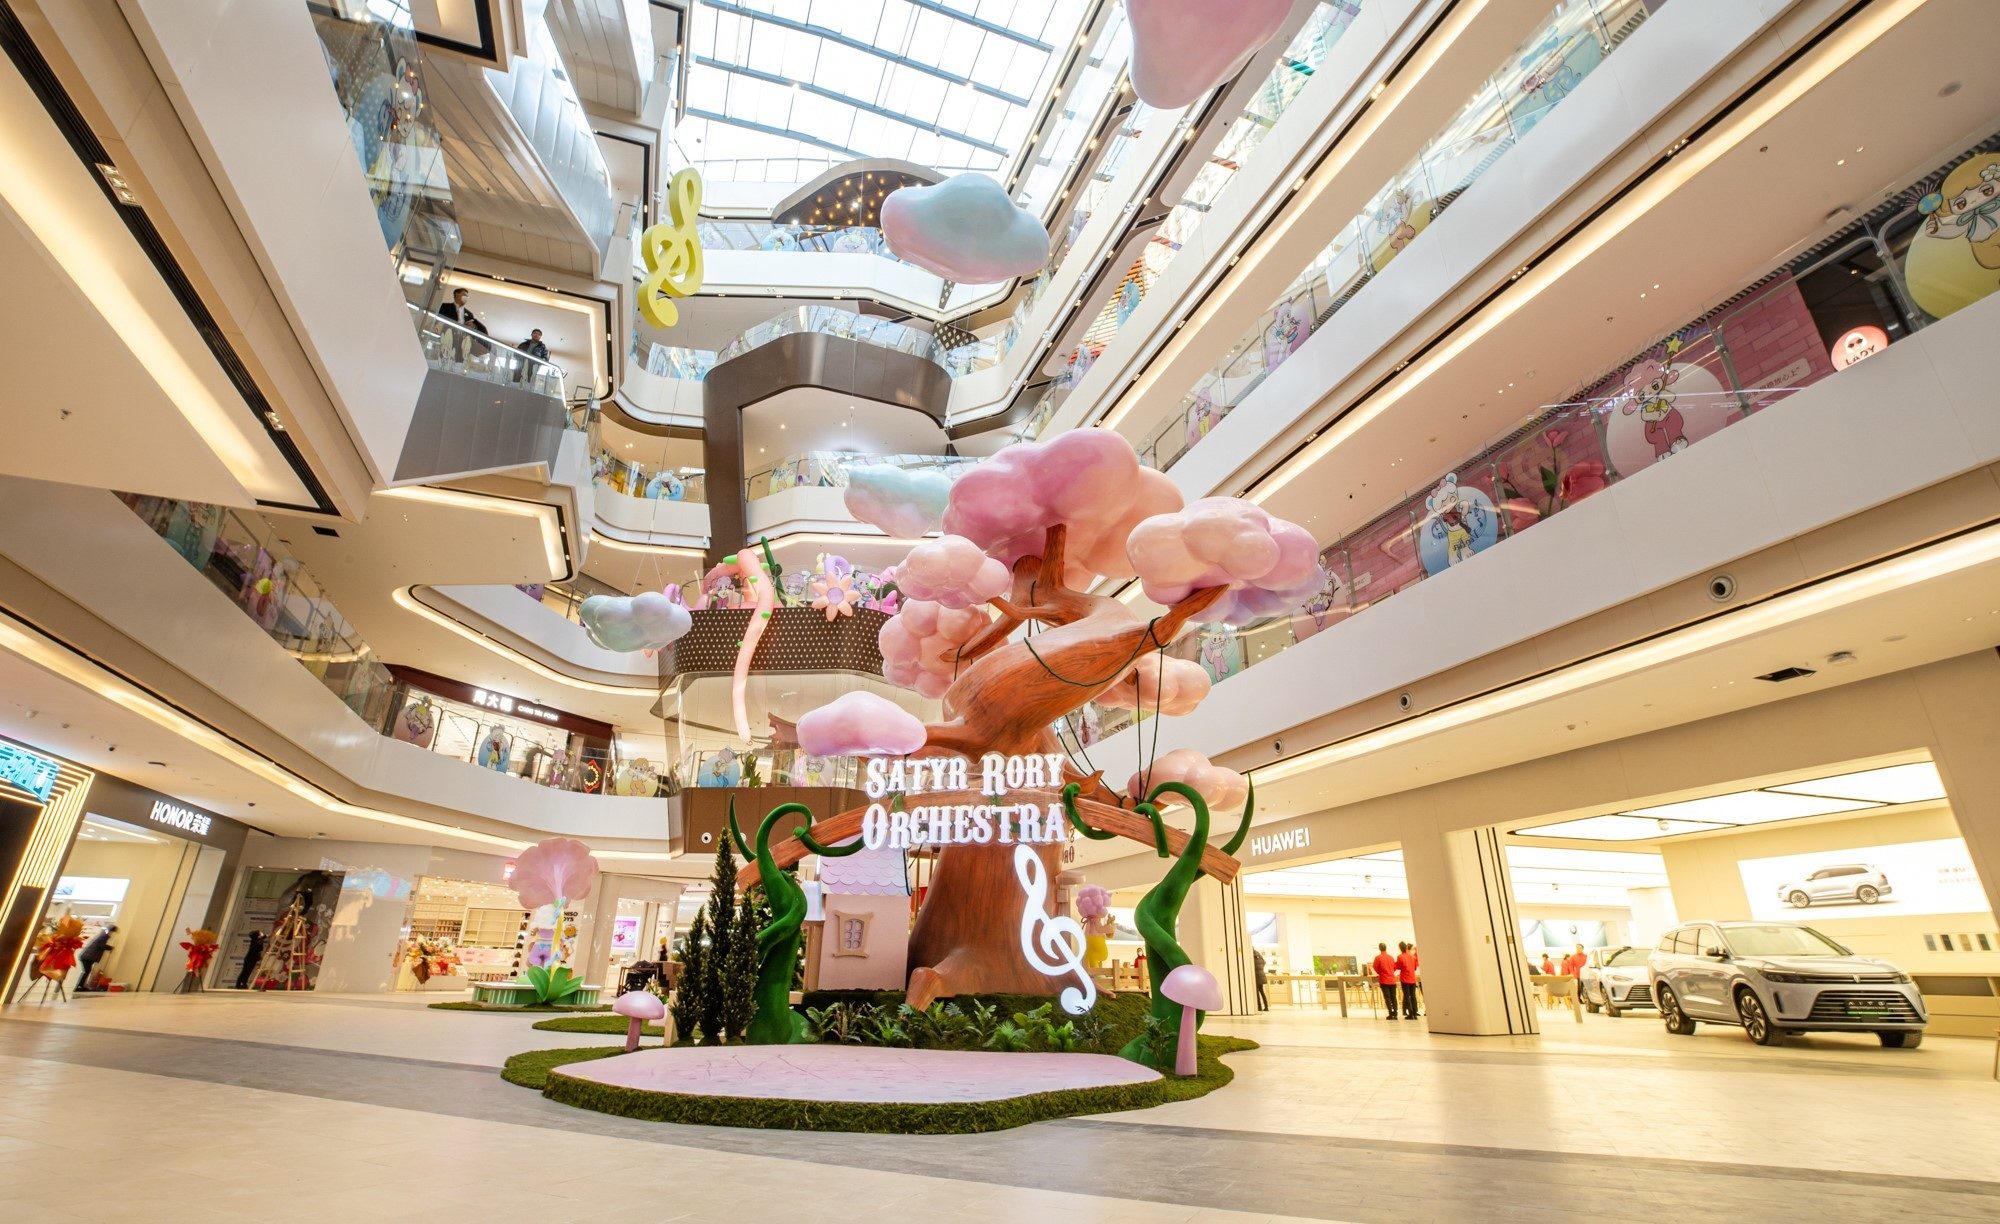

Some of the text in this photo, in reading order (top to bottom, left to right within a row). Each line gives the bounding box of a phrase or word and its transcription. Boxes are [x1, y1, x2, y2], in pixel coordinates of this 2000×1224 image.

[1845, 345, 1876, 366] LADY
[866, 753, 1066, 798] SATYR RORY
[150, 800, 194, 830] HONOR
[861, 803, 1066, 850] ORCHESTRA
[1251, 827, 1310, 857] HUAWEI
